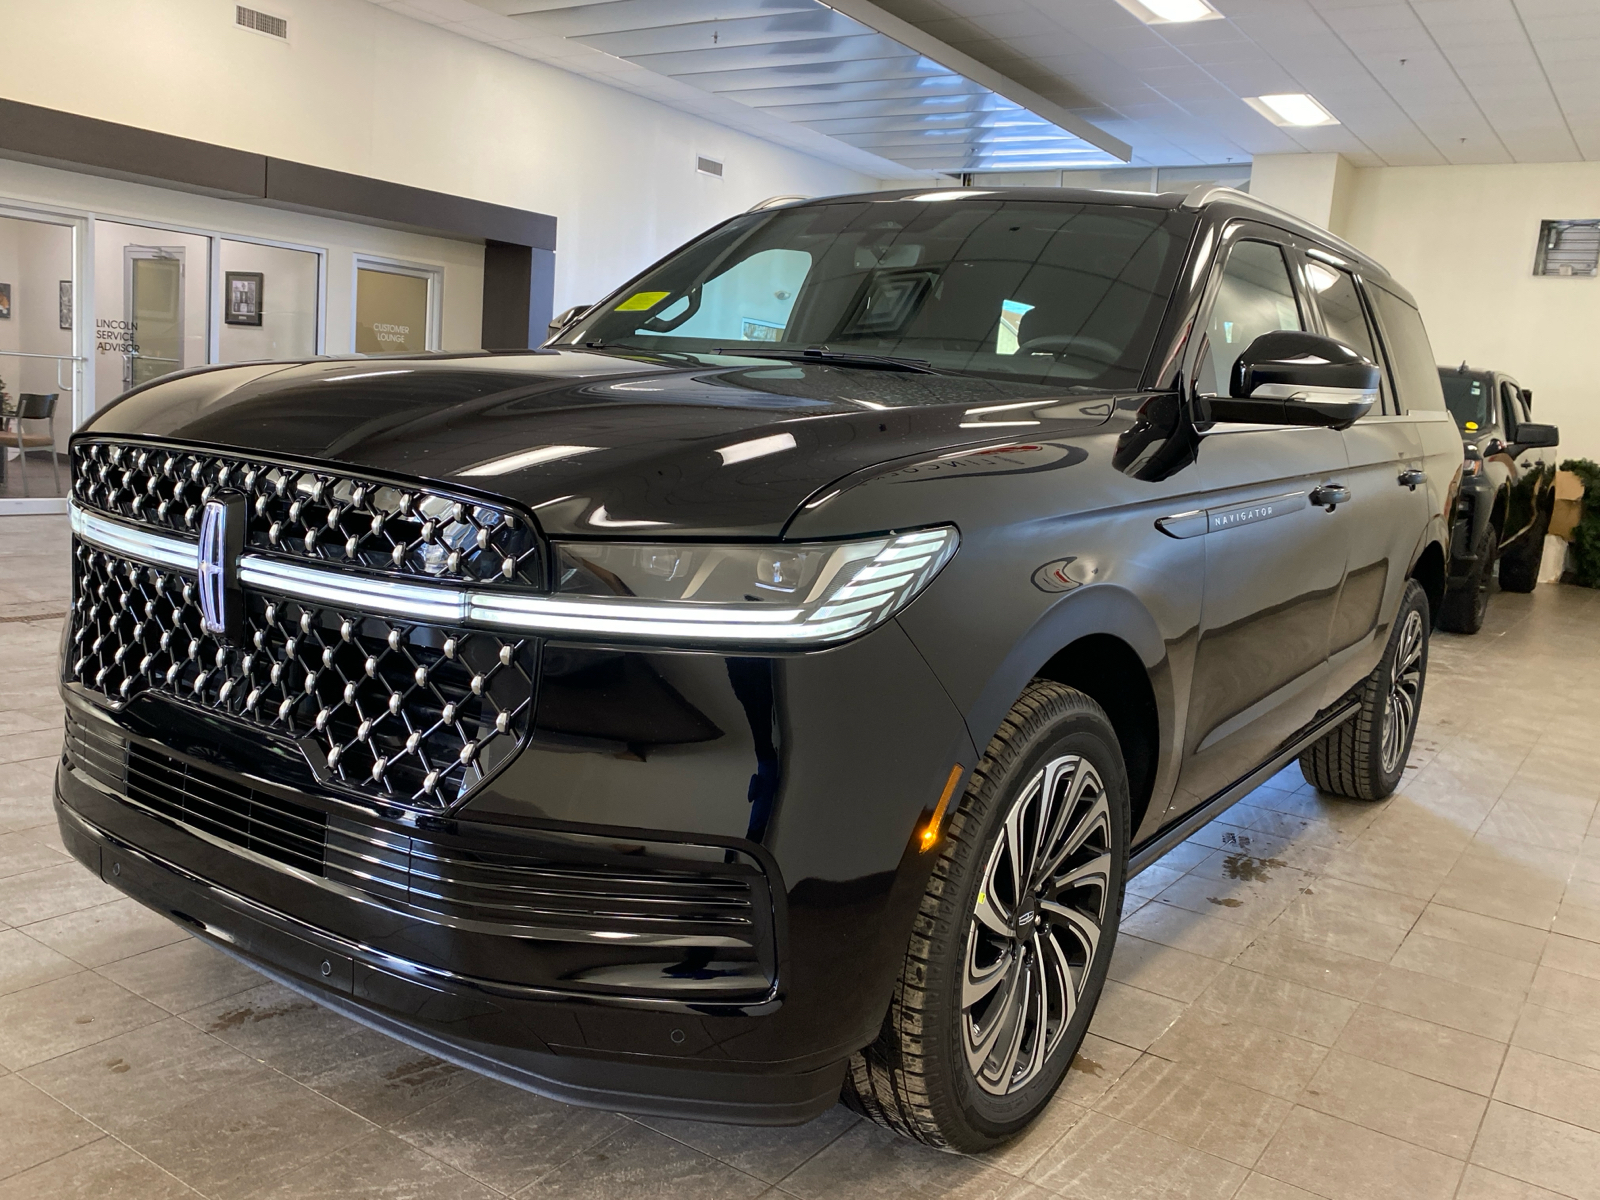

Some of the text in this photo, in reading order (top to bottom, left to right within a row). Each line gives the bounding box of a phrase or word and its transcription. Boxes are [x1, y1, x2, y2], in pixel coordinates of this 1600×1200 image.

[96, 318, 138, 331] LINCOLN
[373, 323, 410, 334] CUSTOMER
[96, 330, 135, 342] SERVICE
[377, 332, 405, 343] LOUNGE
[96, 341, 141, 353] ADVISOR
[1215, 506, 1274, 526] NAVIGATOR
